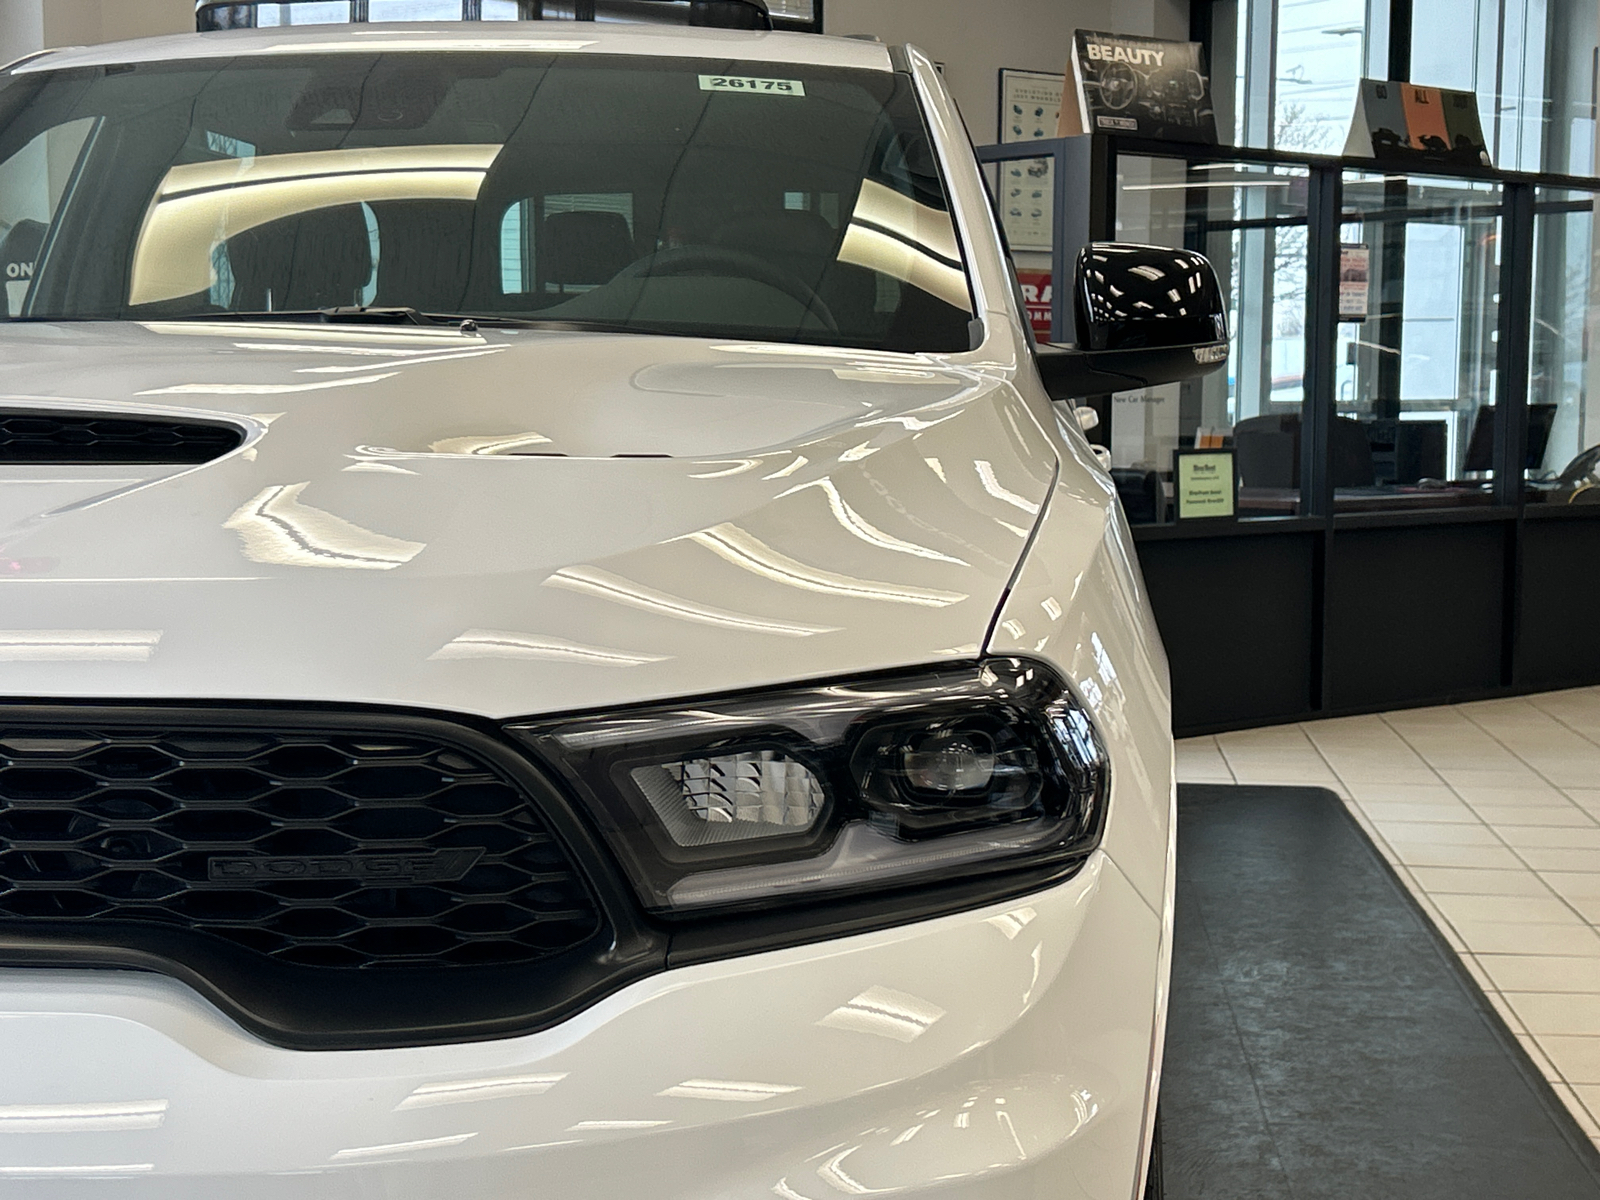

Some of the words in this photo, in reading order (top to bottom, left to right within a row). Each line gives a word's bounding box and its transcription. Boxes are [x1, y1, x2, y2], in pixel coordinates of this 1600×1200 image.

[1086, 43, 1165, 67] BEAUTY
[712, 78, 792, 91] 26175
[211, 857, 437, 877] DODGE
